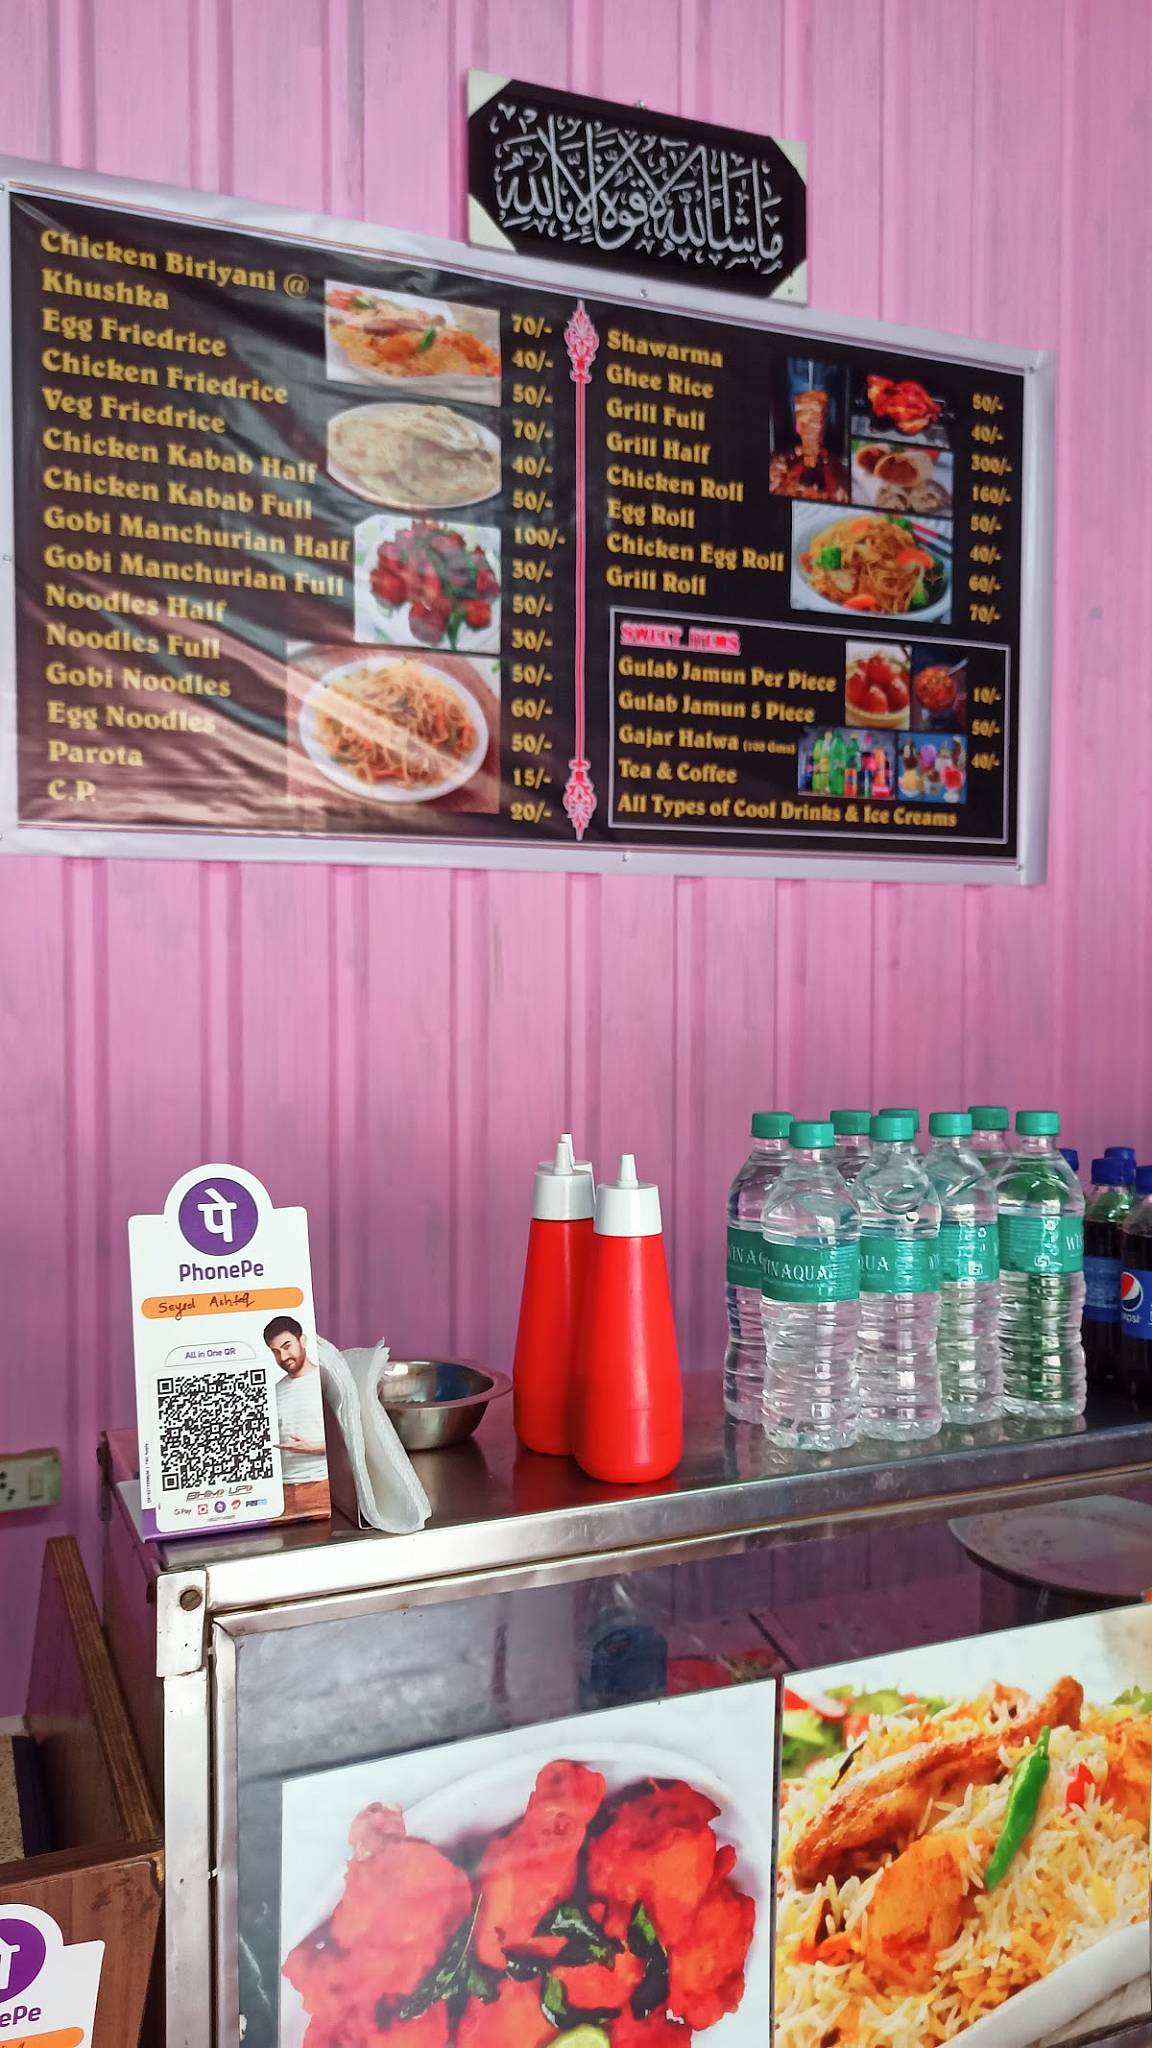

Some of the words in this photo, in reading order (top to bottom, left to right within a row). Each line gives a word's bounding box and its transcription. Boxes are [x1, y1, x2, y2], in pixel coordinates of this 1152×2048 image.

[40, 230, 157, 270] Chicken
[165, 251, 276, 291] Biriyani
[283, 273, 310, 298] @
[41, 268, 169, 310] Khushka
[41, 308, 93, 342] Egg
[100, 317, 227, 357] Friedrice
[512, 315, 553, 337] 70/-
[606, 329, 723, 367] Shawarma
[513, 352, 554, 372] 40/-
[41, 348, 159, 386] Chicken
[167, 367, 288, 405] Friedrice
[606, 363, 662, 392] Ghee
[668, 371, 715, 400] Rice
[513, 386, 554, 408] 50/-
[973, 394, 1004, 414] 50/-
[41, 387, 93, 421] Veg
[100, 395, 226, 433] Friedrice
[606, 397, 657, 424] Grill
[663, 406, 706, 432] Full
[513, 421, 554, 442] 70/-
[971, 426, 1004, 444] 40/-
[43, 427, 159, 464] Chicken
[167, 443, 254, 476] Kabab
[261, 457, 318, 484] Half
[606, 431, 657, 457] Grill
[663, 440, 711, 465] Half
[513, 458, 554, 478] 40/-
[972, 456, 1013, 475] 300/-
[43, 466, 160, 502] Chicken
[168, 481, 254, 511] Kabab
[261, 494, 312, 520] Full
[606, 464, 695, 497] Chicken
[700, 477, 744, 502] Roll
[513, 492, 554, 512] 50/-
[973, 487, 1012, 506] 160/-
[607, 498, 646, 527] Egg
[651, 504, 695, 529] Roll
[43, 505, 111, 535] Gobi
[119, 514, 286, 554] Manchurian
[294, 535, 350, 562] Half
[971, 516, 1003, 535] 50/-
[515, 528, 566, 549] 100/-
[606, 532, 695, 563] Chicken
[700, 543, 738, 570] Egg
[742, 547, 785, 572] Roll
[970, 547, 1002, 564] 40/-
[43, 545, 112, 574] Gobi
[120, 553, 286, 592] Manchurian
[294, 574, 345, 597] Full
[513, 561, 554, 582] 30/-
[606, 566, 657, 591] Grill
[663, 571, 707, 596] Roll
[969, 577, 1001, 595] 60/-
[46, 584, 159, 616] Noodles
[167, 596, 226, 622] Half
[513, 597, 553, 617] 50/-
[970, 606, 1001, 624] 70/-
[46, 623, 160, 655] Noodles
[168, 634, 221, 659] Full
[513, 630, 553, 651] 30/-
[46, 662, 113, 689] Gobi
[123, 669, 232, 697] Noodles
[513, 665, 553, 686] 50/-
[618, 655, 679, 680] Gulab
[682, 660, 746, 686] Jamun
[751, 666, 784, 688] Per
[788, 669, 837, 692] Piece
[618, 689, 679, 713] Gulab
[682, 694, 746, 718] Jamun
[751, 701, 761, 720] 5
[766, 701, 815, 724] Piece
[973, 689, 1001, 705] 10/-
[48, 700, 98, 731] Egg
[105, 706, 216, 733] Noodles
[512, 700, 553, 720] 60/-
[618, 723, 675, 749] Gajar
[679, 728, 740, 751] Halwa
[972, 721, 1000, 737] 50/-
[48, 740, 144, 766] Parota
[513, 735, 553, 755] 50/-
[618, 757, 653, 780] Tea
[656, 763, 673, 781] &
[677, 763, 738, 785] Coffee
[971, 755, 1000, 770] 40/-
[47, 779, 97, 802] C.P.
[514, 770, 552, 789] 15/-
[511, 804, 552, 823] 20/-
[617, 793, 646, 813] All
[652, 795, 705, 817] Types
[710, 798, 730, 817] of
[734, 798, 776, 819] Cool
[781, 801, 841, 822] Drinks
[844, 805, 859, 823] &
[863, 804, 889, 824] Ice
[893, 807, 958, 828] Creams
[197, 1187, 238, 1243] पे
[179, 1259, 265, 1282] PhonePe
[185, 1351, 197, 1360] All
[198, 1350, 205, 1358] in
[206, 1349, 223, 1358] One
[224, 1346, 236, 1356] QR
